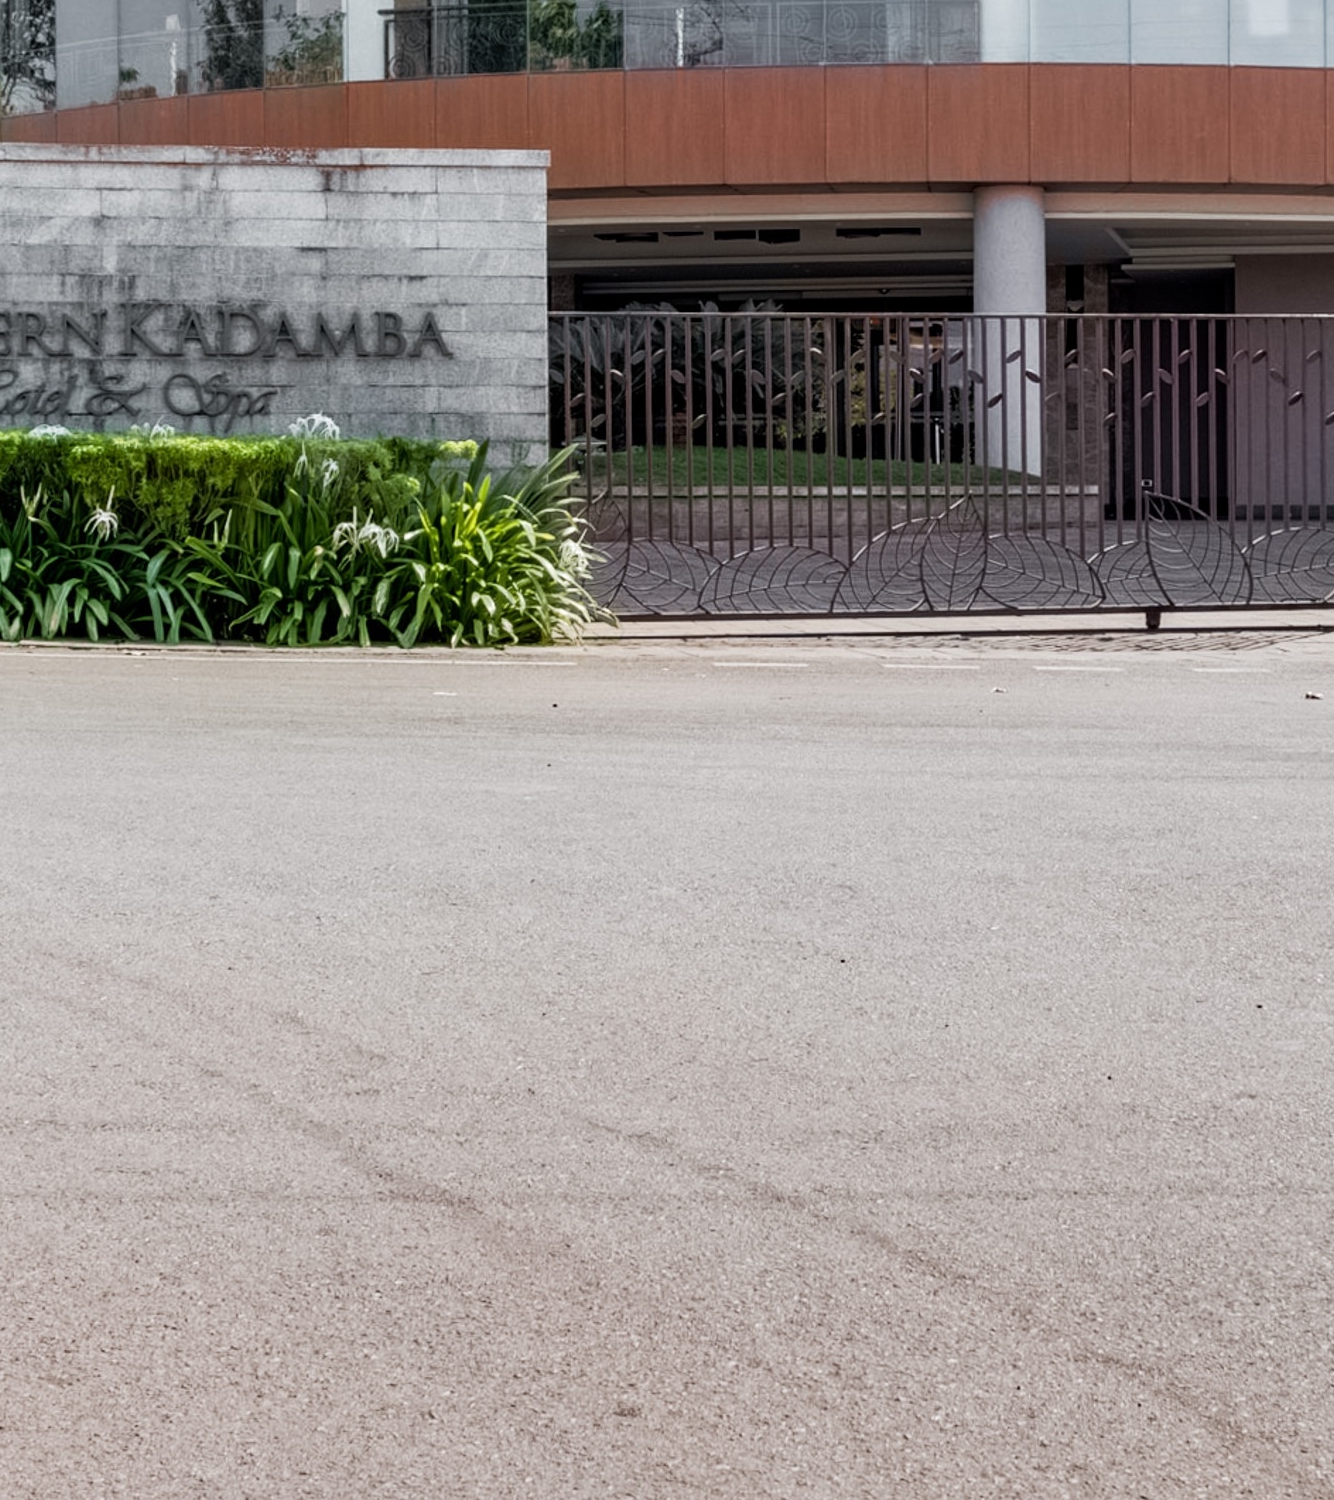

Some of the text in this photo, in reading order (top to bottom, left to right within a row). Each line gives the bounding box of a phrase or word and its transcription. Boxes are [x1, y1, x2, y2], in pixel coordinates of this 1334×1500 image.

[119, 301, 454, 359] KADAMBA
[84, 374, 146, 417] &
[164, 372, 278, 434] Spa
